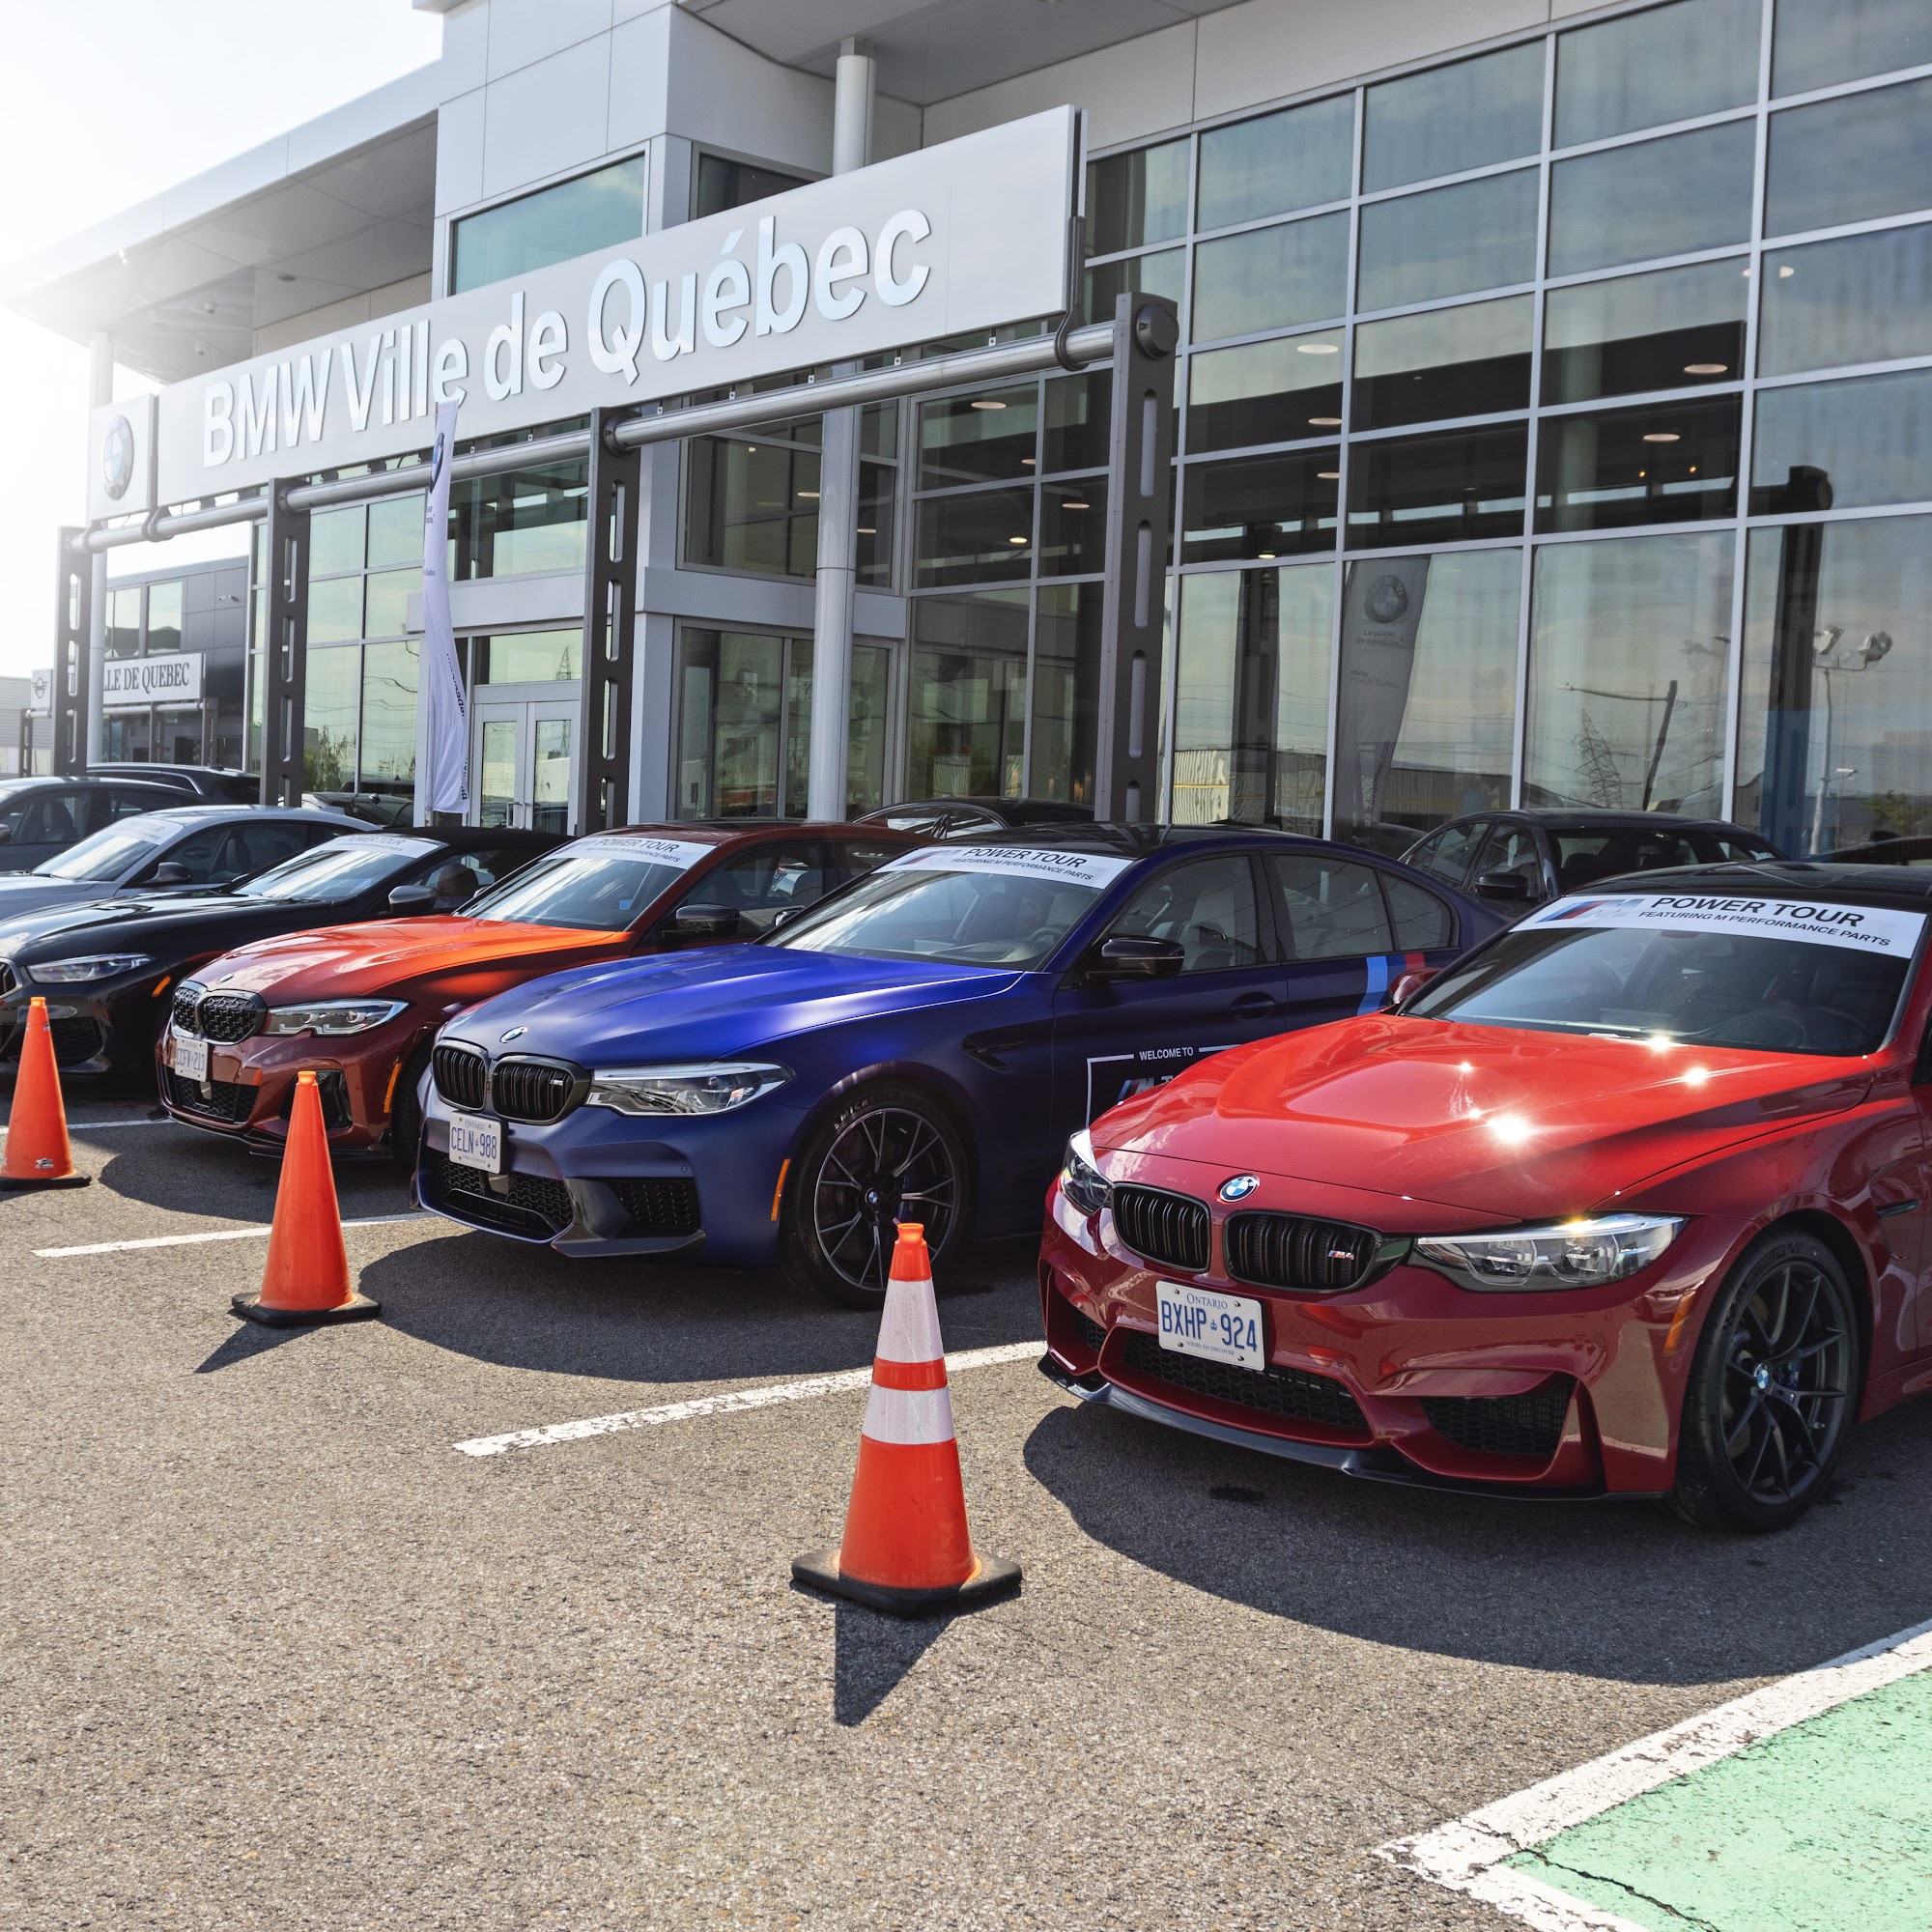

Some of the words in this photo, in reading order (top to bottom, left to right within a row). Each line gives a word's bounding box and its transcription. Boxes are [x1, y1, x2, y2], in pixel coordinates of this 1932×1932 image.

[203, 348, 333, 469] BMW
[341, 319, 469, 432] Ville
[484, 291, 568, 401] de
[587, 209, 931, 386] Québec
[124, 668, 139, 690] DE
[142, 663, 189, 694] QUEBEC
[595, 838, 639, 848] POWER
[641, 839, 680, 853] TOUR
[962, 848, 1030, 860] POWER
[1032, 851, 1088, 868] TOUR
[1001, 860, 1065, 874] PERFORMANCE
[1064, 869, 1094, 881] PARTS
[1650, 897, 1767, 914] POWER
[1773, 903, 1865, 927] TOUR
[1638, 911, 1714, 920] FEATURING
[1728, 915, 1840, 935] PERFORMANCE
[1839, 930, 1891, 947] PARTS
[1139, 1048, 1181, 1061] WELCOME
[1181, 1046, 1194, 1057] TO
[451, 1126, 474, 1154] CELN
[479, 1133, 497, 1160] 988
[1186, 1293, 1228, 1310] ONTARIO
[1161, 1300, 1207, 1340] BXHP
[1220, 1314, 1257, 1352] 924
